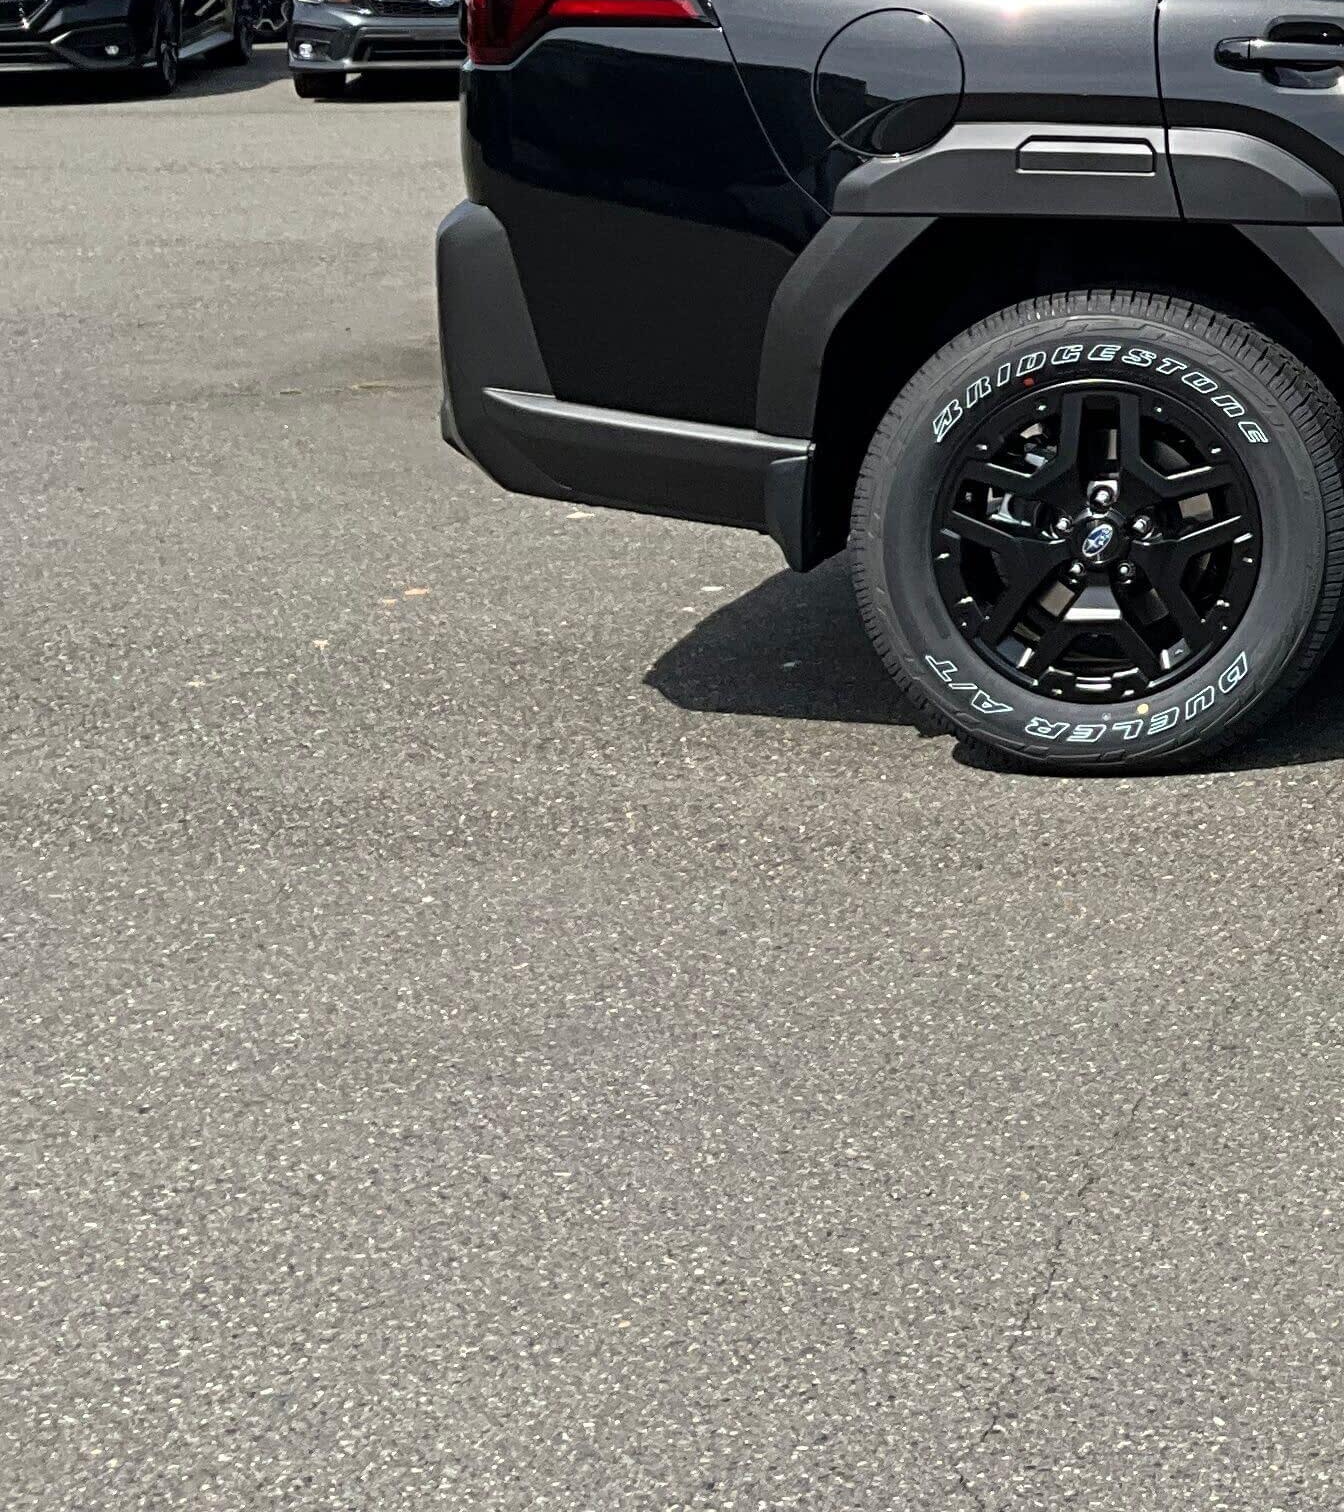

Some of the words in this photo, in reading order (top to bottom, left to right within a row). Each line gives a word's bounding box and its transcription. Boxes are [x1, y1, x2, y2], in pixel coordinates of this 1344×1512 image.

[932, 344, 1269, 443] BRIDGESTONE
[925, 654, 1014, 715] A/T
[1025, 651, 1249, 743] DUELER
